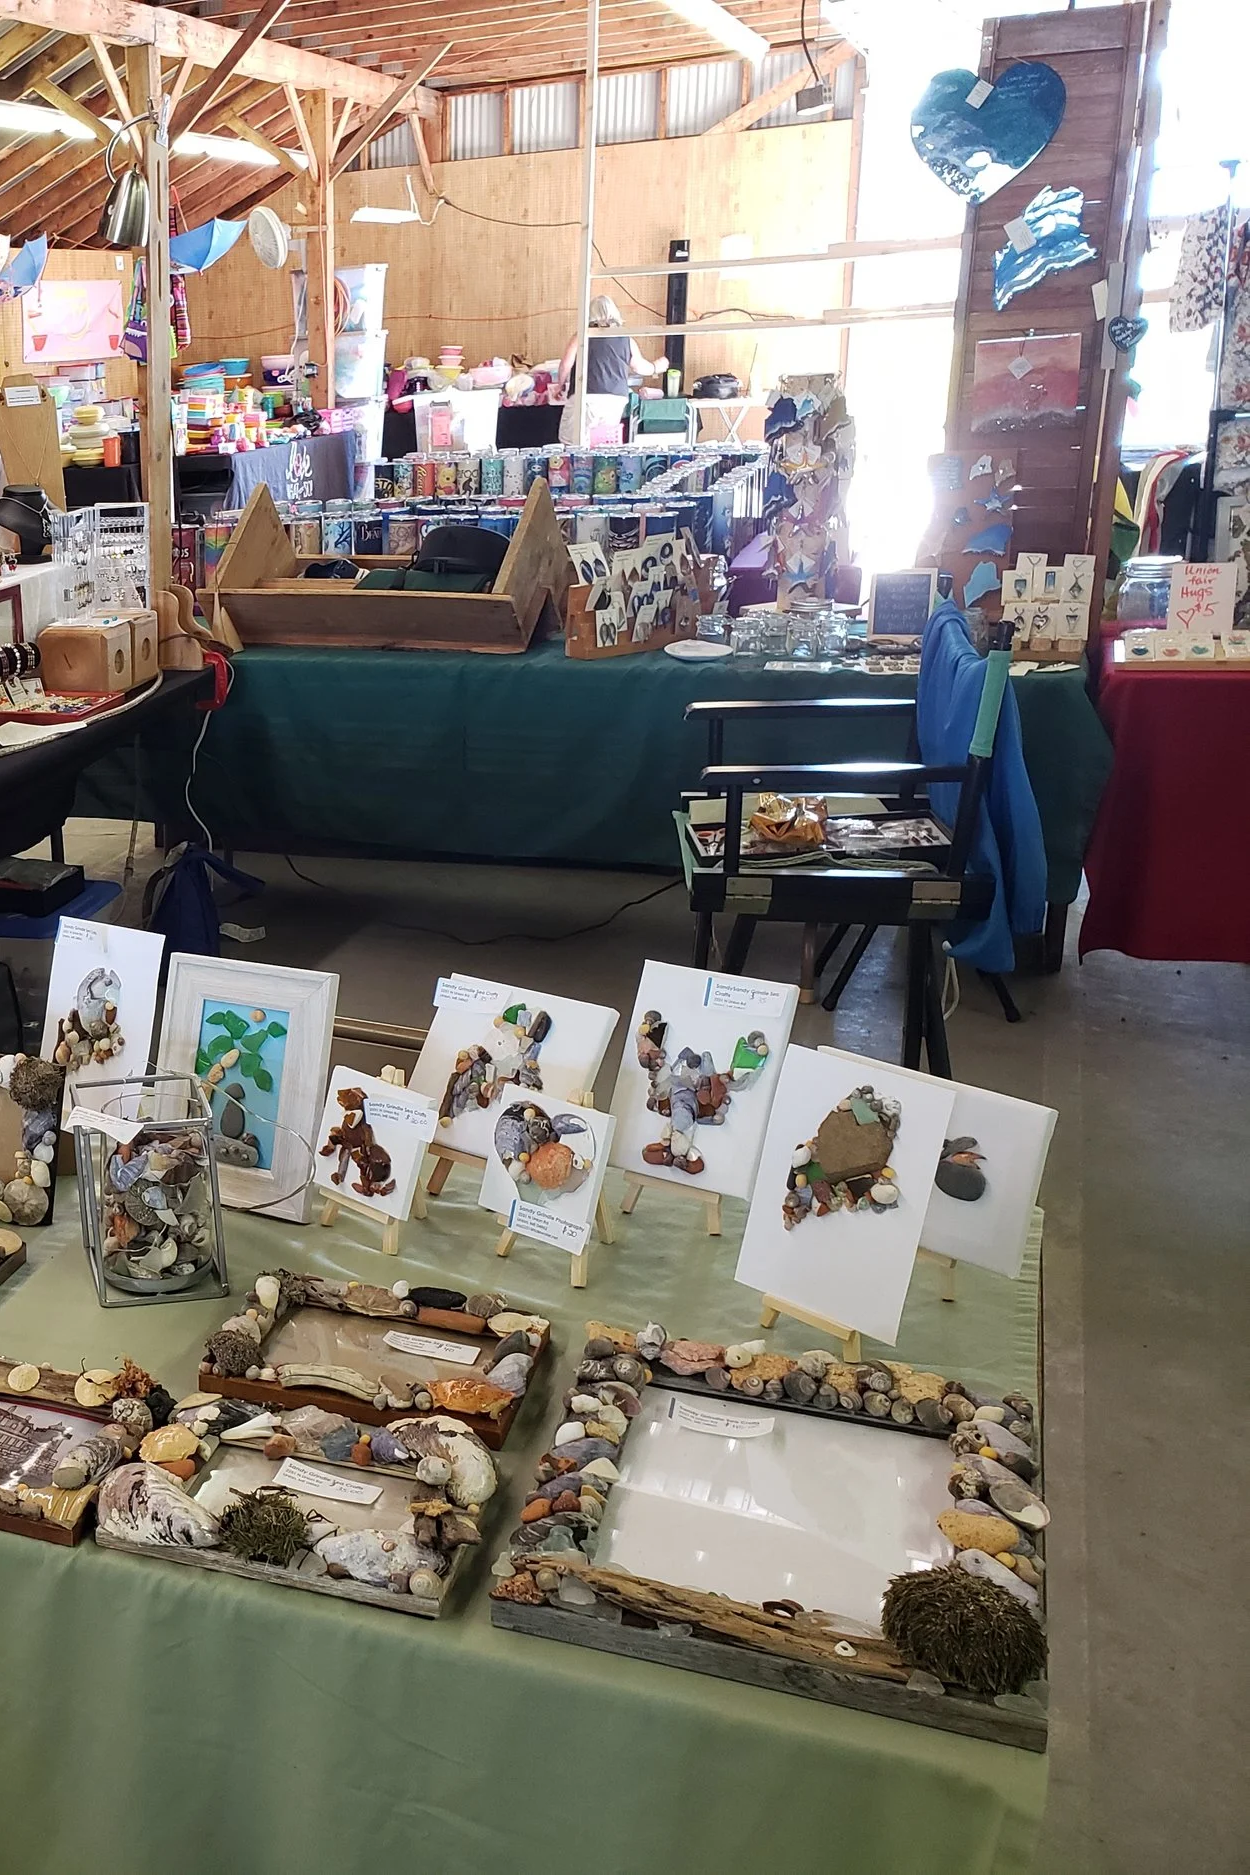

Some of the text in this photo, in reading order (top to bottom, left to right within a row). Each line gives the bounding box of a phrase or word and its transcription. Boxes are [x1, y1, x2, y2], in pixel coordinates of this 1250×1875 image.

[1185, 565, 1221, 575] Union
[1189, 576, 1217, 585] fair
[1181, 586, 1213, 601] Hugs
[519, 1205, 535, 1215] Sandy
[537, 1210, 555, 1221] Grindle
[555, 1217, 585, 1232] Photography
[288, 1463, 307, 1474] Sandy
[308, 1469, 330, 1482] Grindle
[345, 1482, 364, 1490] Crafts
